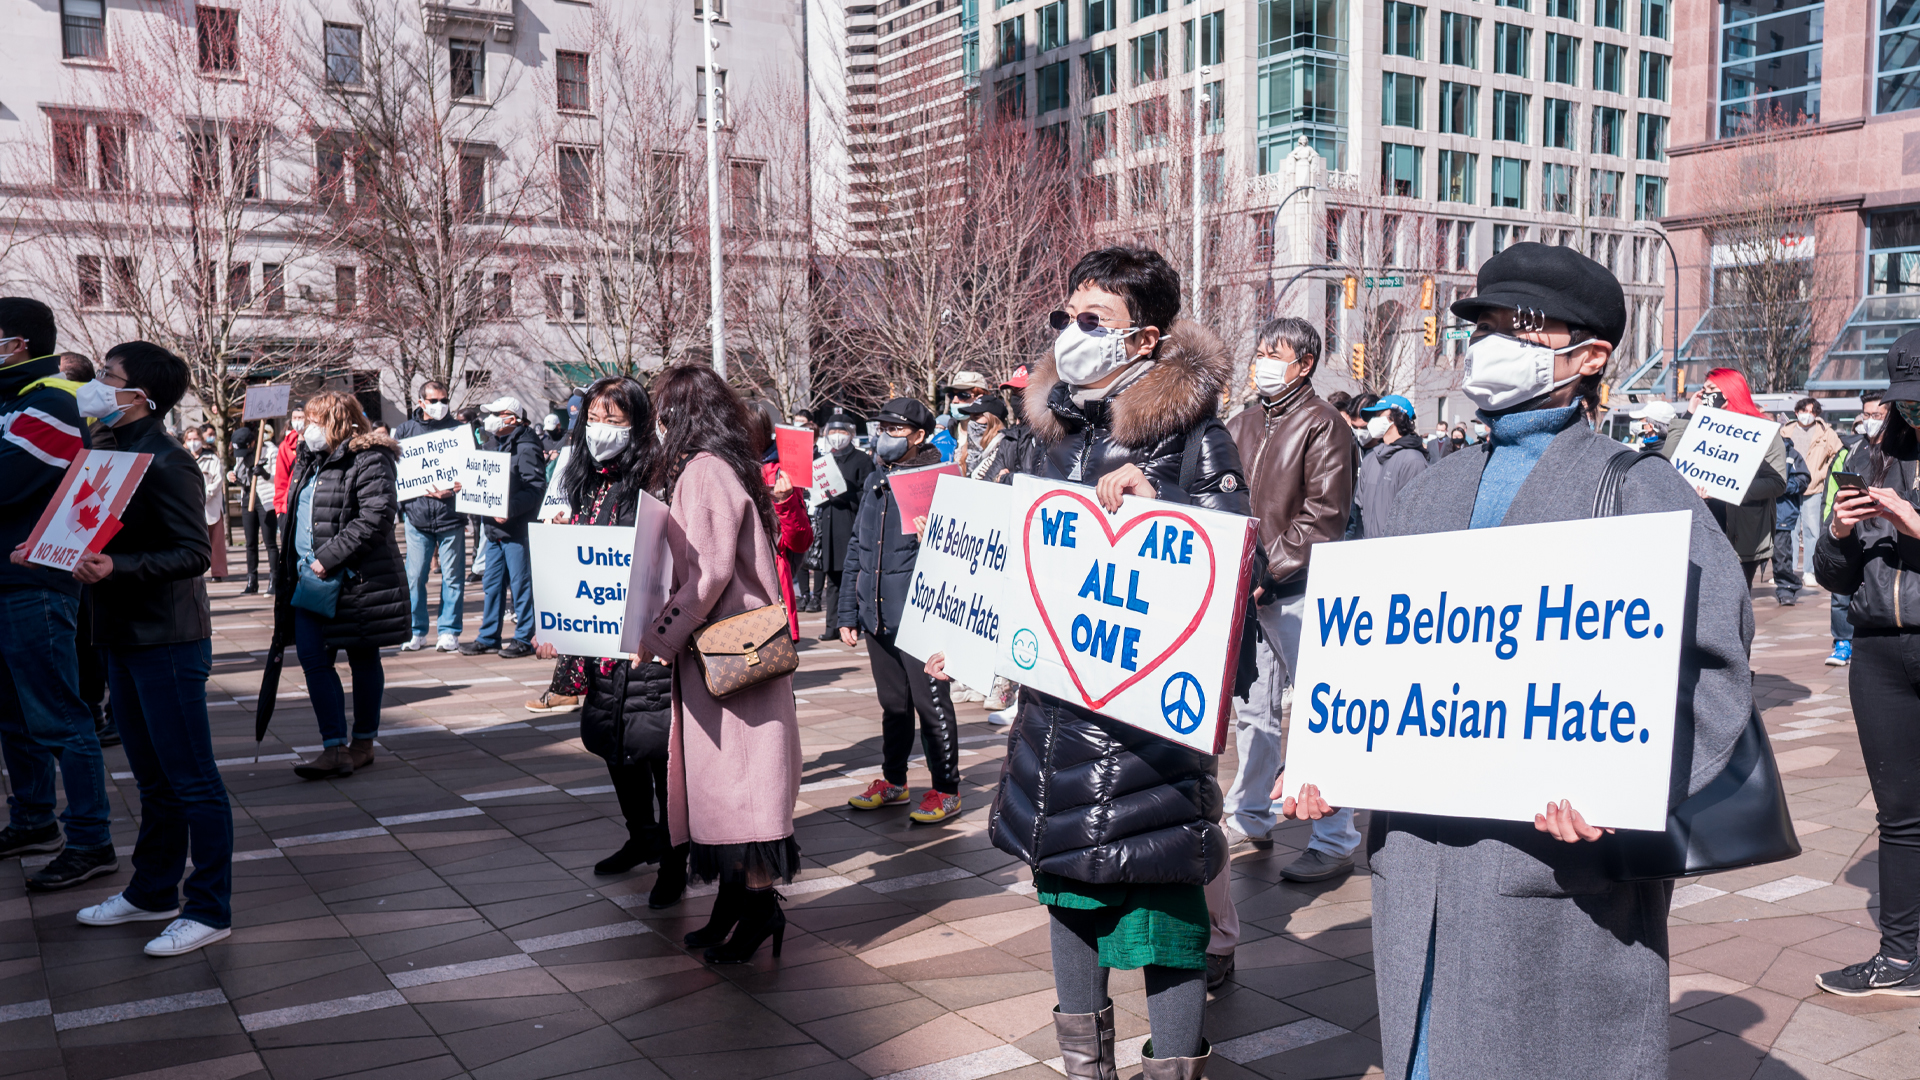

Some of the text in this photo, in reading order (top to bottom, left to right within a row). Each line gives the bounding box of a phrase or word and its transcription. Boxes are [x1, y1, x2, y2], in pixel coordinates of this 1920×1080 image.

[1697, 415, 1762, 443] Protect
[427, 438, 459, 454] Rights
[1693, 440, 1740, 464] Asian
[421, 457, 440, 469] Are
[466, 457, 501, 476] Asian Rights
[813, 460, 827, 470] Need
[1675, 458, 1740, 491] Women.
[396, 474, 434, 491] Human
[476, 474, 488, 489] Are
[813, 473, 826, 481] Love
[820, 480, 830, 489] And
[461, 489, 503, 509] Human Rights!
[926, 513, 944, 551] We
[943, 518, 985, 576] Belong
[1041, 507, 1195, 565] WE ARE
[34, 542, 79, 566] NO HATE
[575, 580, 627, 606] Agai
[911, 571, 936, 623] Stop
[933, 581, 966, 627] Asian
[1077, 559, 1150, 615] ALL
[1317, 583, 1665, 660] We Belong Here.
[1071, 613, 1142, 673] ONE
[1308, 681, 1650, 753] Stop Asian Hate.
